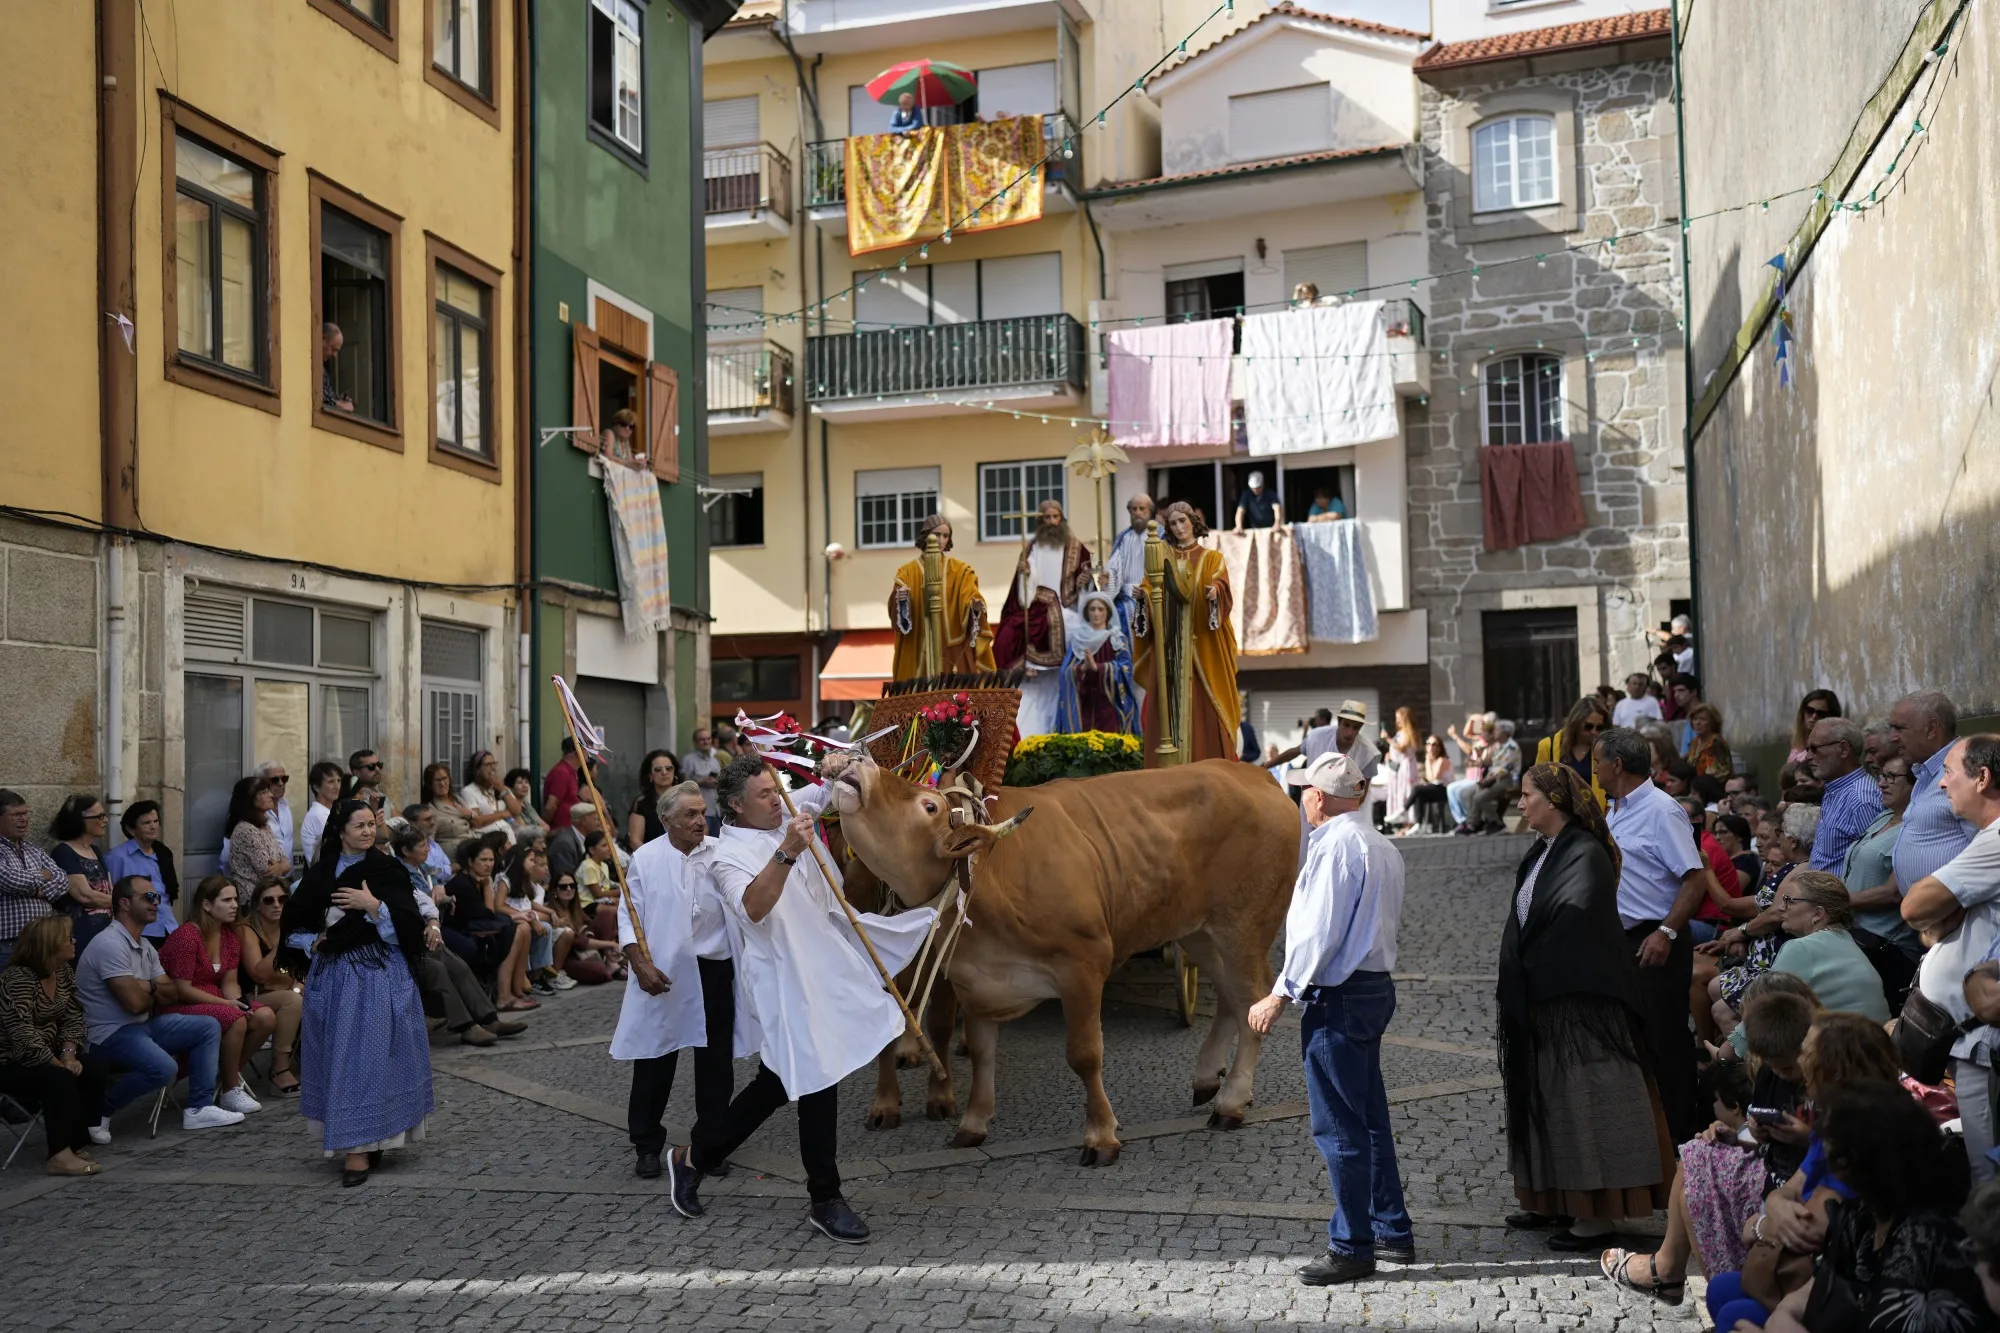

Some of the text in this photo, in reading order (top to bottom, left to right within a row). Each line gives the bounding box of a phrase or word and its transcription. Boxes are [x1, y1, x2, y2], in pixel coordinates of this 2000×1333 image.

[291, 573, 306, 590] 9 A
[449, 601, 455, 616] 9
